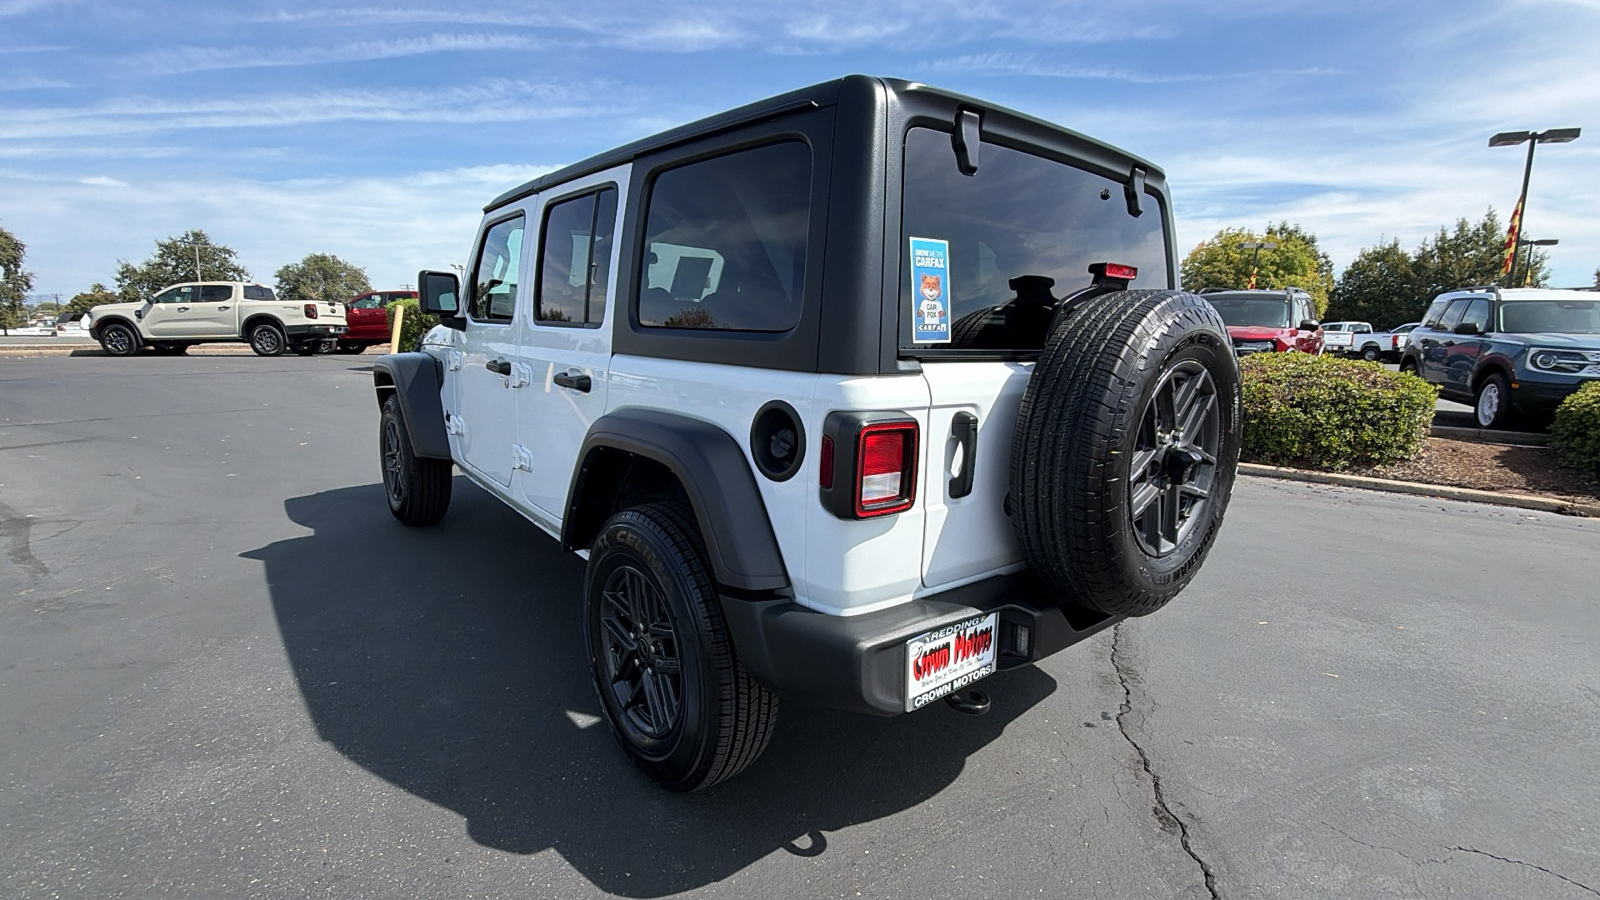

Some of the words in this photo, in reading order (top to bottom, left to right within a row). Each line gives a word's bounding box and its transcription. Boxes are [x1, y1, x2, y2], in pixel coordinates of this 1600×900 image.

[915, 256, 945, 269] CARFAX
[926, 303, 937, 311] CAR
[926, 311, 937, 319] FOX
[931, 617, 979, 641] REDDING
[913, 643, 950, 681] Crown
[954, 627, 992, 664] Motors
[914, 683, 951, 707] CROWN
[952, 665, 992, 690] MOTORS
